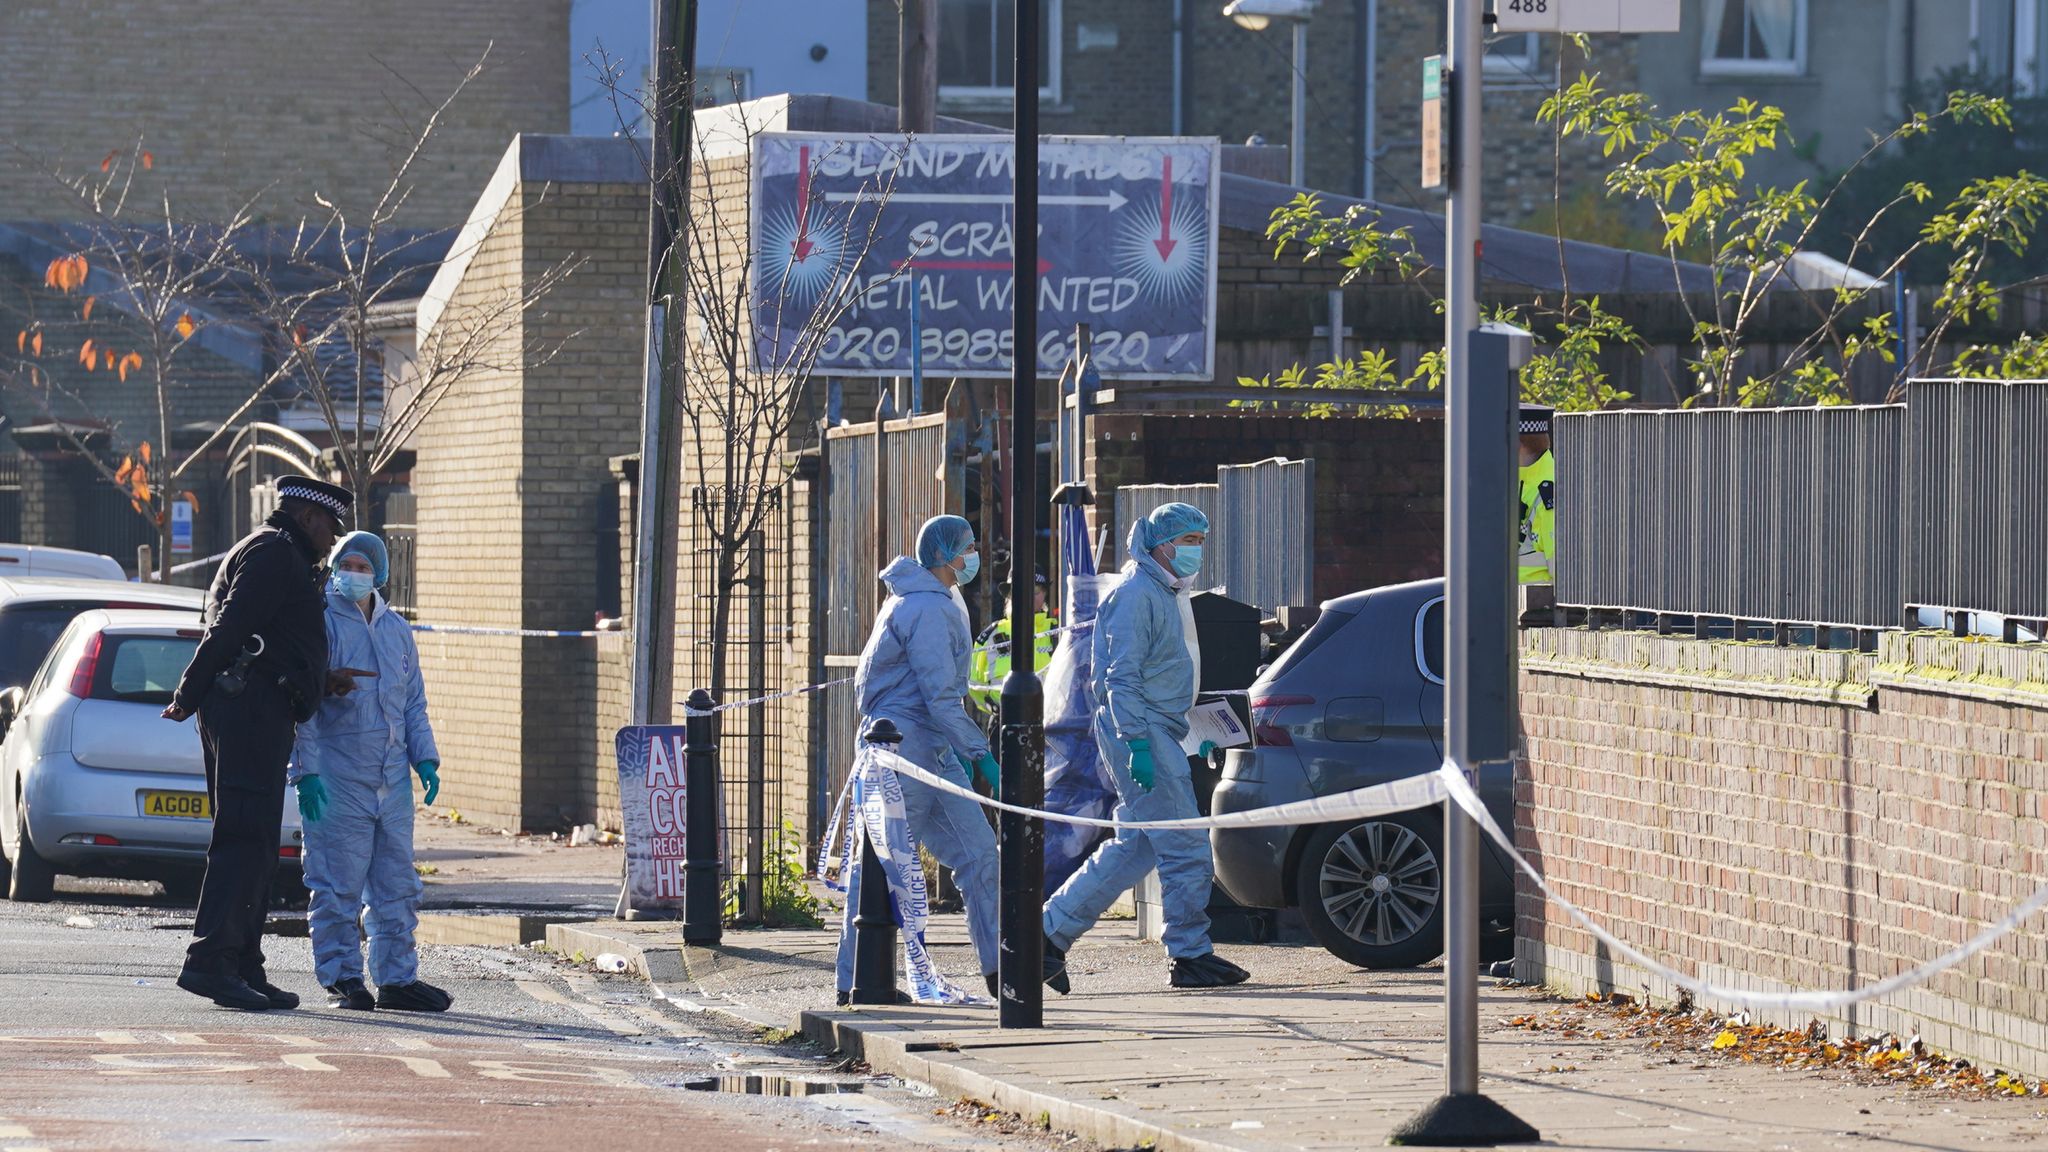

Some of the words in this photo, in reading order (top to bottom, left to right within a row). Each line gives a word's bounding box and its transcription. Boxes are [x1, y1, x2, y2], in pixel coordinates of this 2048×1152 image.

[1509, 0, 1547, 13] 488
[908, 221, 1043, 257] SCRA
[825, 274, 959, 311] METAL
[977, 275, 1140, 313] WNTED
[817, 326, 901, 362] 020
[153, 796, 203, 814] AG08
[912, 873, 928, 917] POLICE
